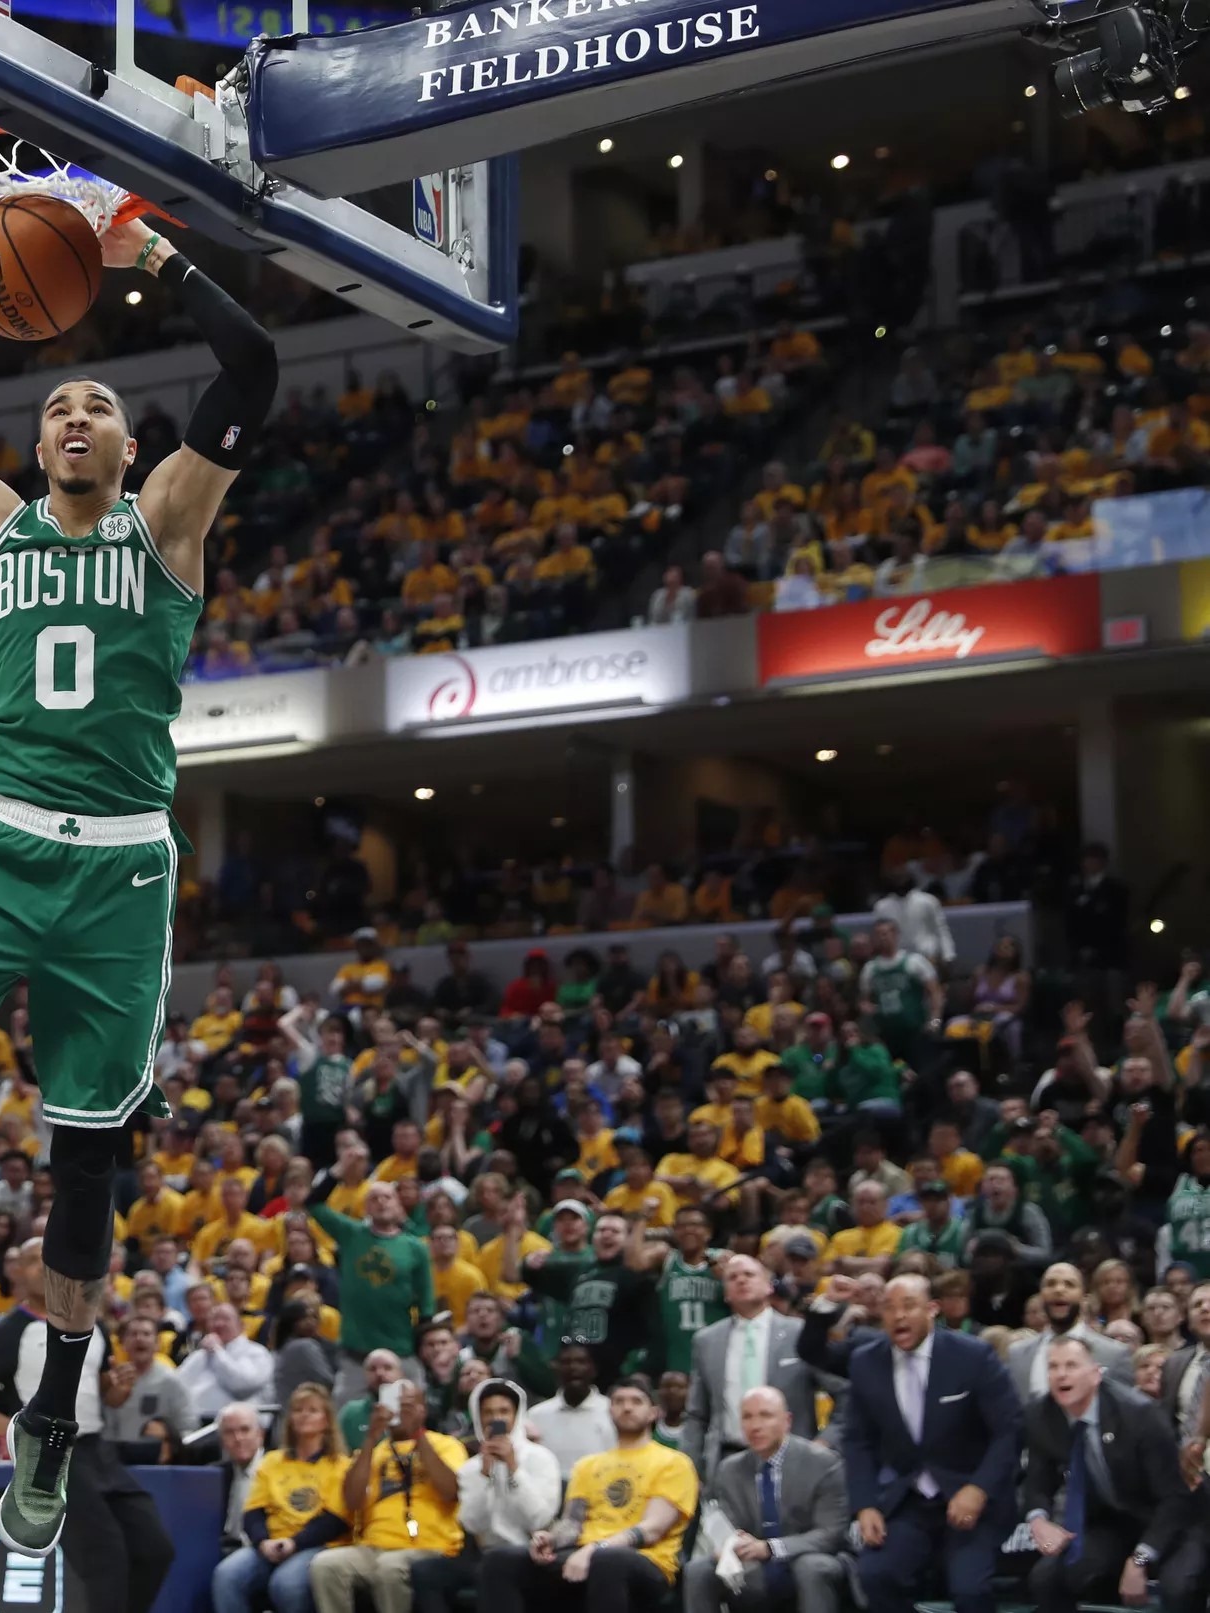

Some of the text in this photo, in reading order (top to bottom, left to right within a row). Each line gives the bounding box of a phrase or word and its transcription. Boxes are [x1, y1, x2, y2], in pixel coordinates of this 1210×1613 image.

[423, 0, 648, 48] BANKE
[417, 4, 760, 102] FIELDHOUSE
[417, 207, 433, 235] NBA
[864, 598, 986, 660] Lilly
[35, 624, 95, 710] 0
[489, 649, 649, 693] ambrose
